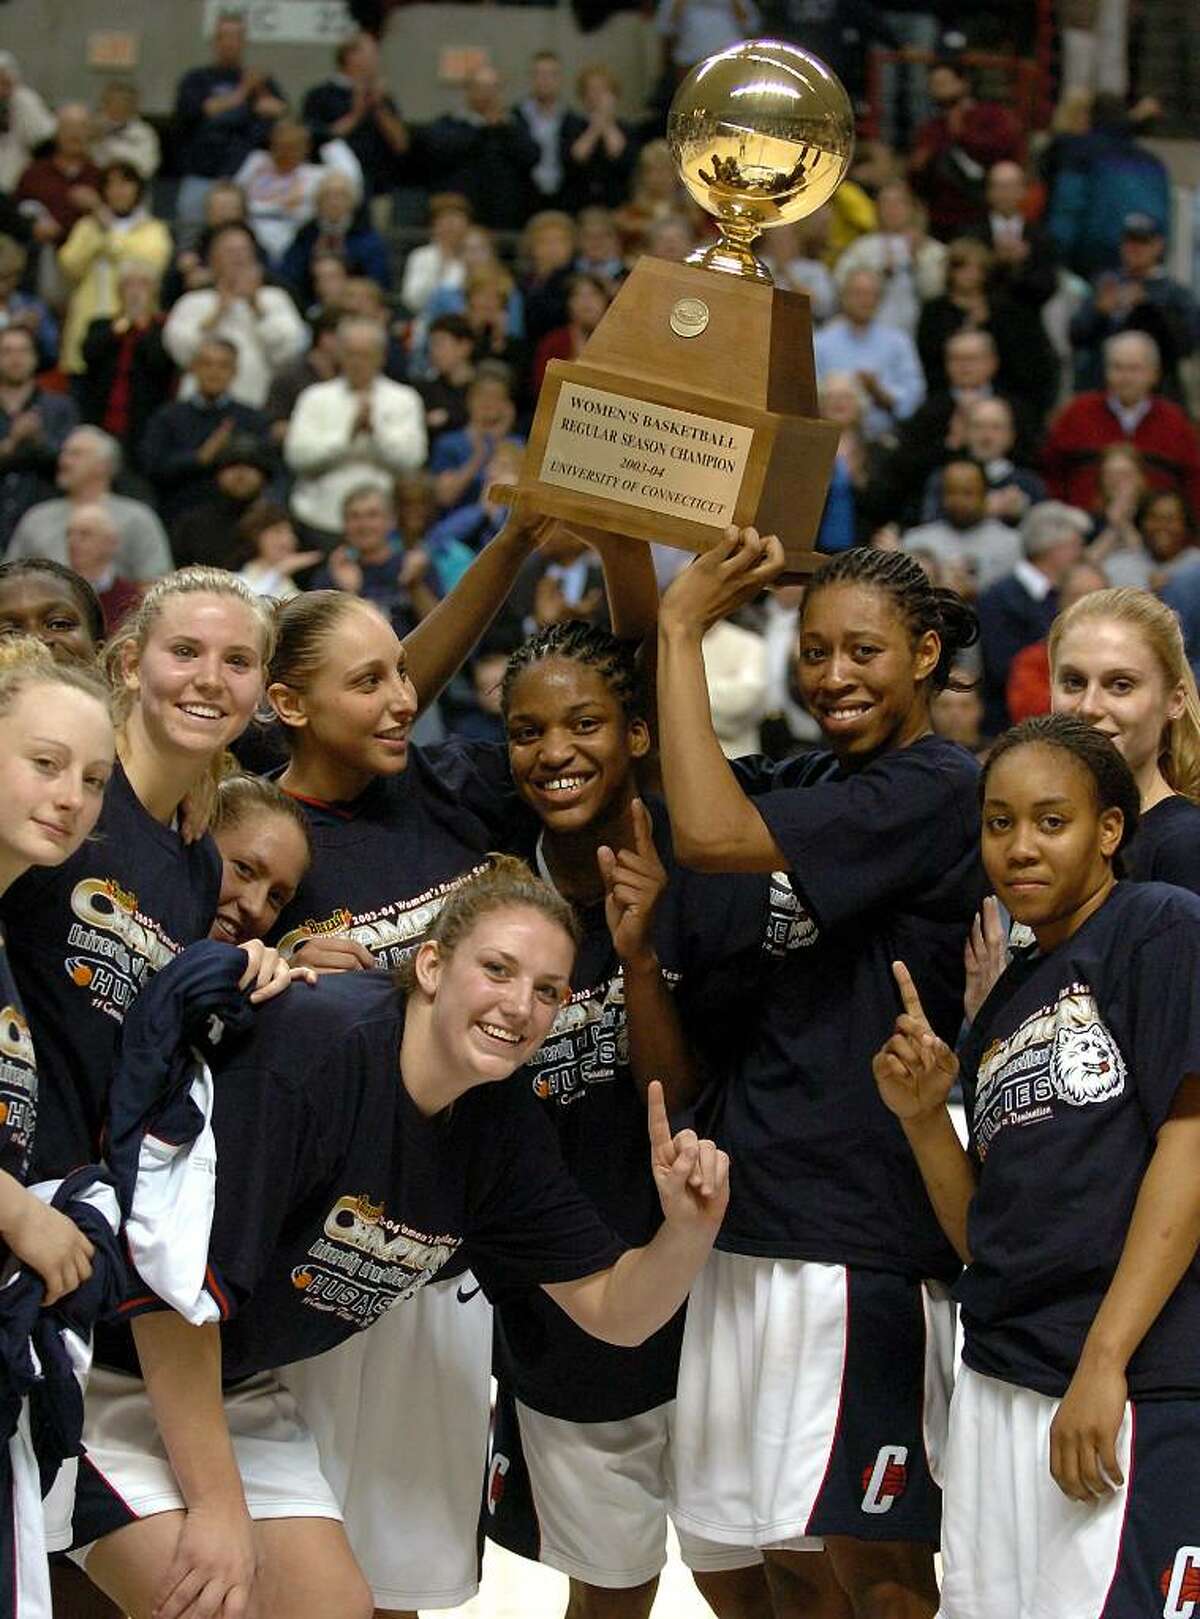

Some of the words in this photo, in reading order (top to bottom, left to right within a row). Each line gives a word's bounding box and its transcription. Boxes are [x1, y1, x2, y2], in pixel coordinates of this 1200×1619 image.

[560, 417, 617, 443] REGULAR
[620, 433, 666, 455] SEASON
[670, 446, 736, 473] CHAMPION
[571, 396, 640, 424] WOMEN'S
[642, 415, 738, 450] BASKETBALL
[550, 460, 621, 488] UNIVERSITY
[622, 478, 638, 491] OF
[641, 484, 727, 515] CONNECTICUT
[619, 457, 667, 478] 2003-04
[352, 904, 396, 926] 2003-04
[395, 887, 440, 914] Women's
[861, 1445, 908, 1514] C
[1163, 1546, 1200, 1619] C
